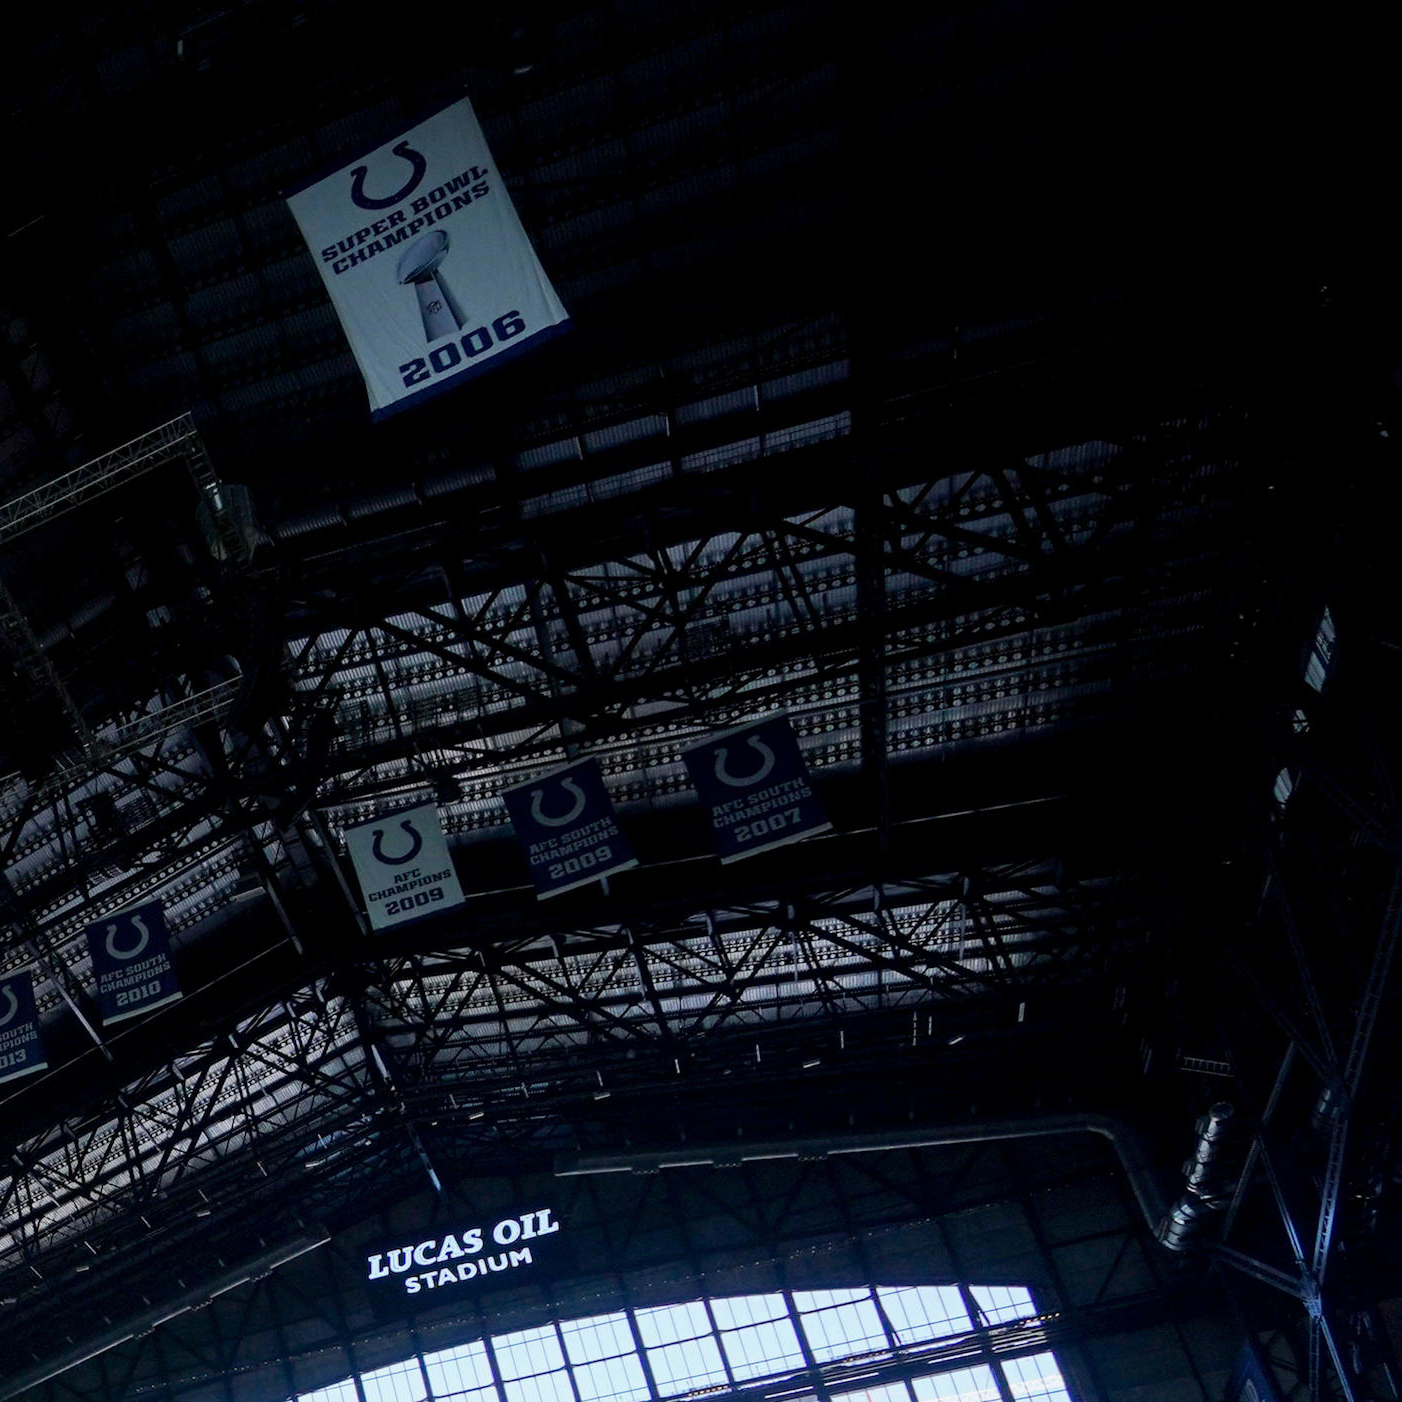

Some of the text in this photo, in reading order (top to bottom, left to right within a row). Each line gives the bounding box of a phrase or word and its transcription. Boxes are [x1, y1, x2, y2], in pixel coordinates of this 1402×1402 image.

[321, 164, 489, 263] SUPER BOWL
[332, 180, 490, 275] CHAMPIONS
[399, 310, 526, 388] 2006
[733, 807, 802, 843] 2007
[394, 869, 421, 884] AFC
[548, 845, 613, 880] 2009
[369, 869, 451, 901] CHAMPIONS
[386, 888, 444, 915] 2009
[368, 1208, 559, 1280] LUCAS OIL
[405, 1248, 532, 1294] STADIUM
